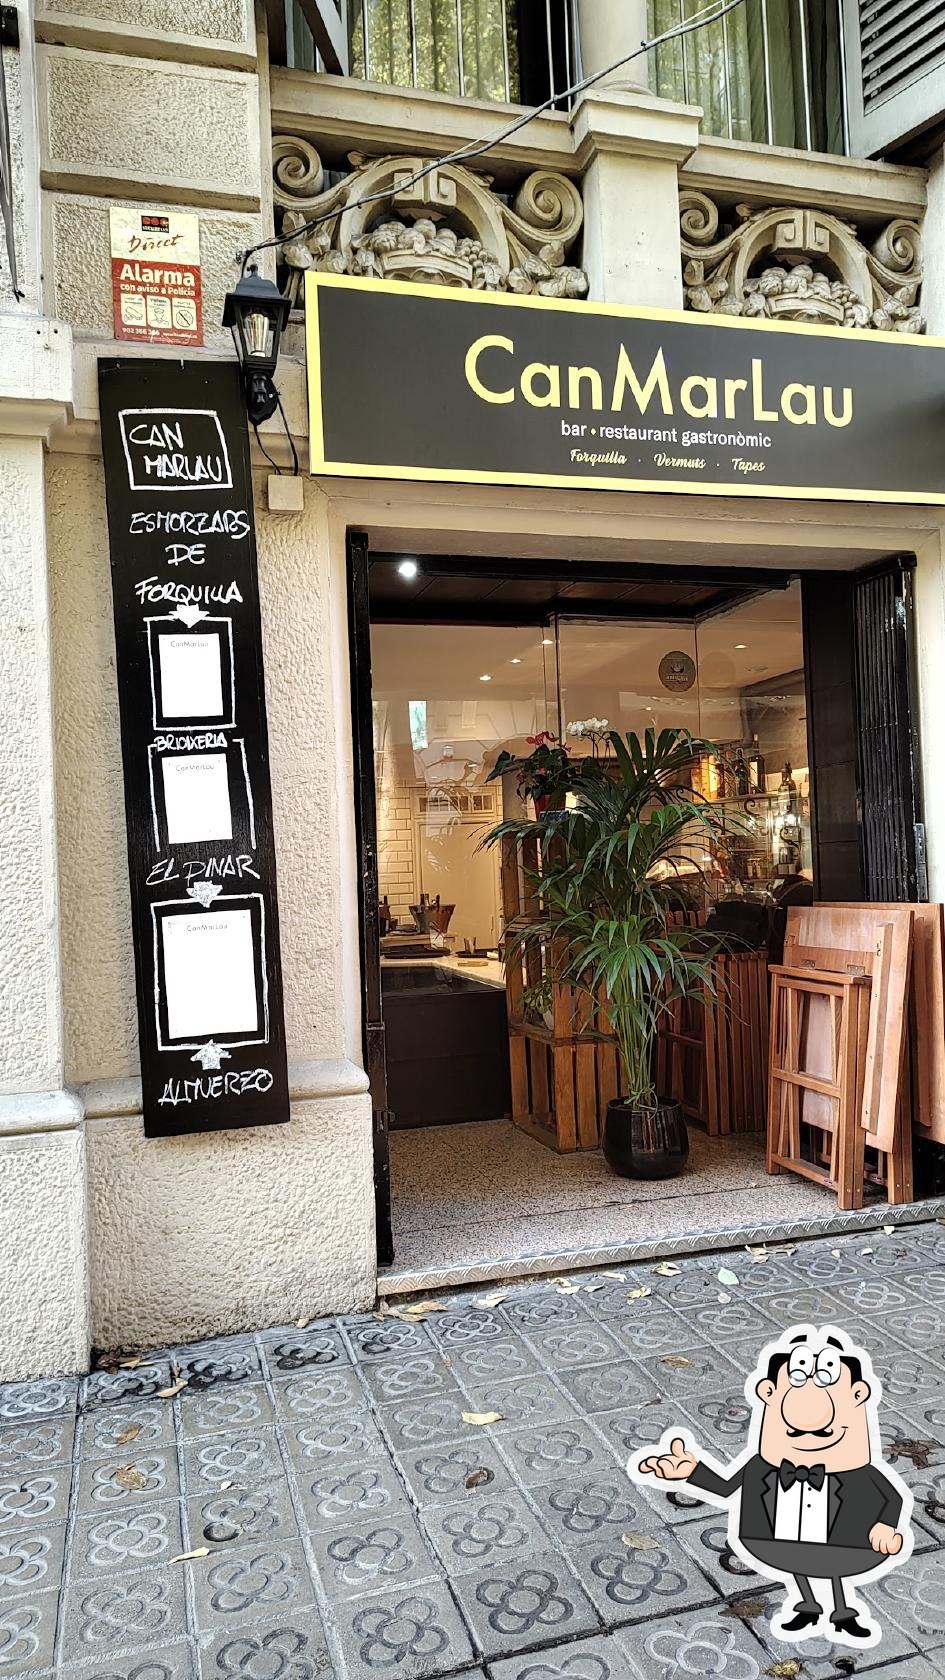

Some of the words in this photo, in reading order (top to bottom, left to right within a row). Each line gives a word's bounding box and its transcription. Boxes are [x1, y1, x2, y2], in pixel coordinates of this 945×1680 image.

[120, 263, 195, 287] Alarma
[137, 284, 159, 293] aviso
[464, 334, 854, 428] CanMarLau
[129, 421, 184, 451] CAN
[561, 420, 587, 437] bar
[599, 424, 678, 443] restaurant
[681, 430, 772, 447] gastronòmic
[143, 454, 222, 482] MARLAU
[569, 449, 627, 465] Forquilla
[653, 453, 706, 469] Vermuts
[731, 458, 765, 474] Tapes
[165, 543, 206, 566] DE
[134, 576, 243, 606] FORQUILLA
[146, 857, 180, 886] EL
[157, 1069, 274, 1106] ALMUERZO
